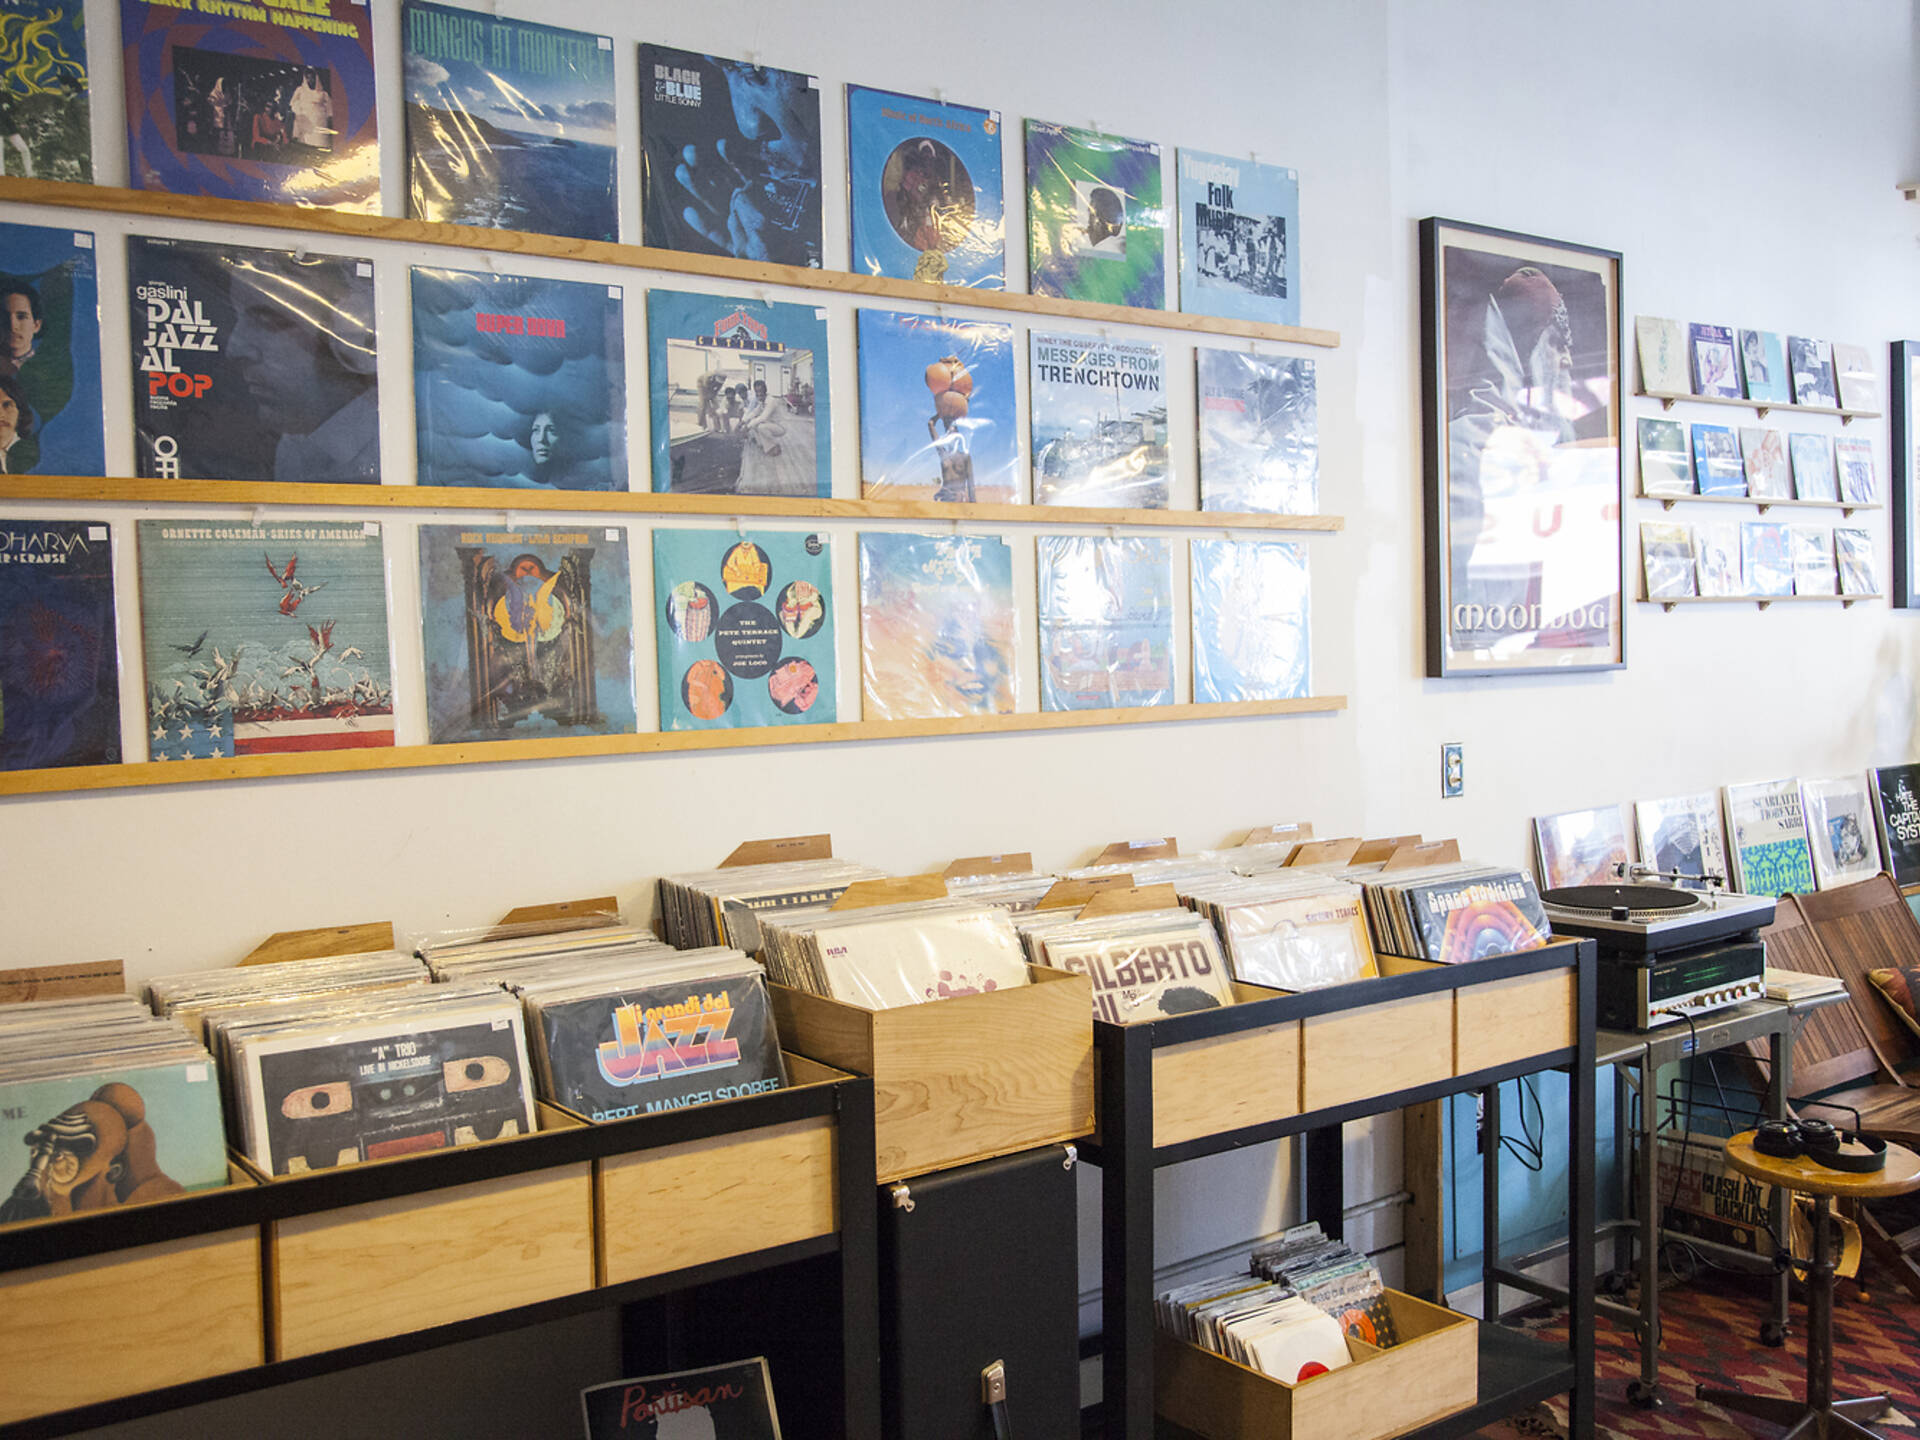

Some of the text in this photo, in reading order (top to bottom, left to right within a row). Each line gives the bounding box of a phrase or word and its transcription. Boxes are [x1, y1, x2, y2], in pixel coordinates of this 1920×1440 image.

[196, 0, 267, 23] RHYTHM
[270, 15, 359, 39] HAPPENING
[409, 8, 484, 66] MINGUS
[491, 25, 513, 69] AT
[654, 64, 701, 85] BLACK
[665, 81, 702, 100] BLUE
[1208, 181, 1234, 211] Folk
[136, 284, 188, 300] gaslini
[147, 299, 211, 327] DAL
[476, 312, 566, 338] SUPER NOVA
[143, 325, 219, 352] JAZZ
[140, 348, 181, 373] AL
[1038, 346, 1159, 372] MESSAGES FROM
[149, 371, 213, 399] POP
[1038, 364, 1160, 392] TRENCHTOWN
[161, 528, 212, 539] ORNETTE
[214, 528, 266, 540] COLEMAN
[303, 529, 317, 540] OF
[319, 528, 367, 540] AMERICA
[20, 553, 67, 564] KRAUSE
[731, 638, 767, 646] QUINTET
[1902, 799, 1919, 812] THE
[1889, 811, 1920, 827] CAPITA
[1064, 941, 1212, 991] GILBERTO
[703, 989, 731, 1012] del
[394, 1041, 417, 1058] TRIO
[595, 1005, 742, 1086] JAZZ
[359, 1062, 376, 1076] LIVE
[1702, 1172, 1740, 1201] CLASH
[619, 1383, 744, 1429] Partisan
